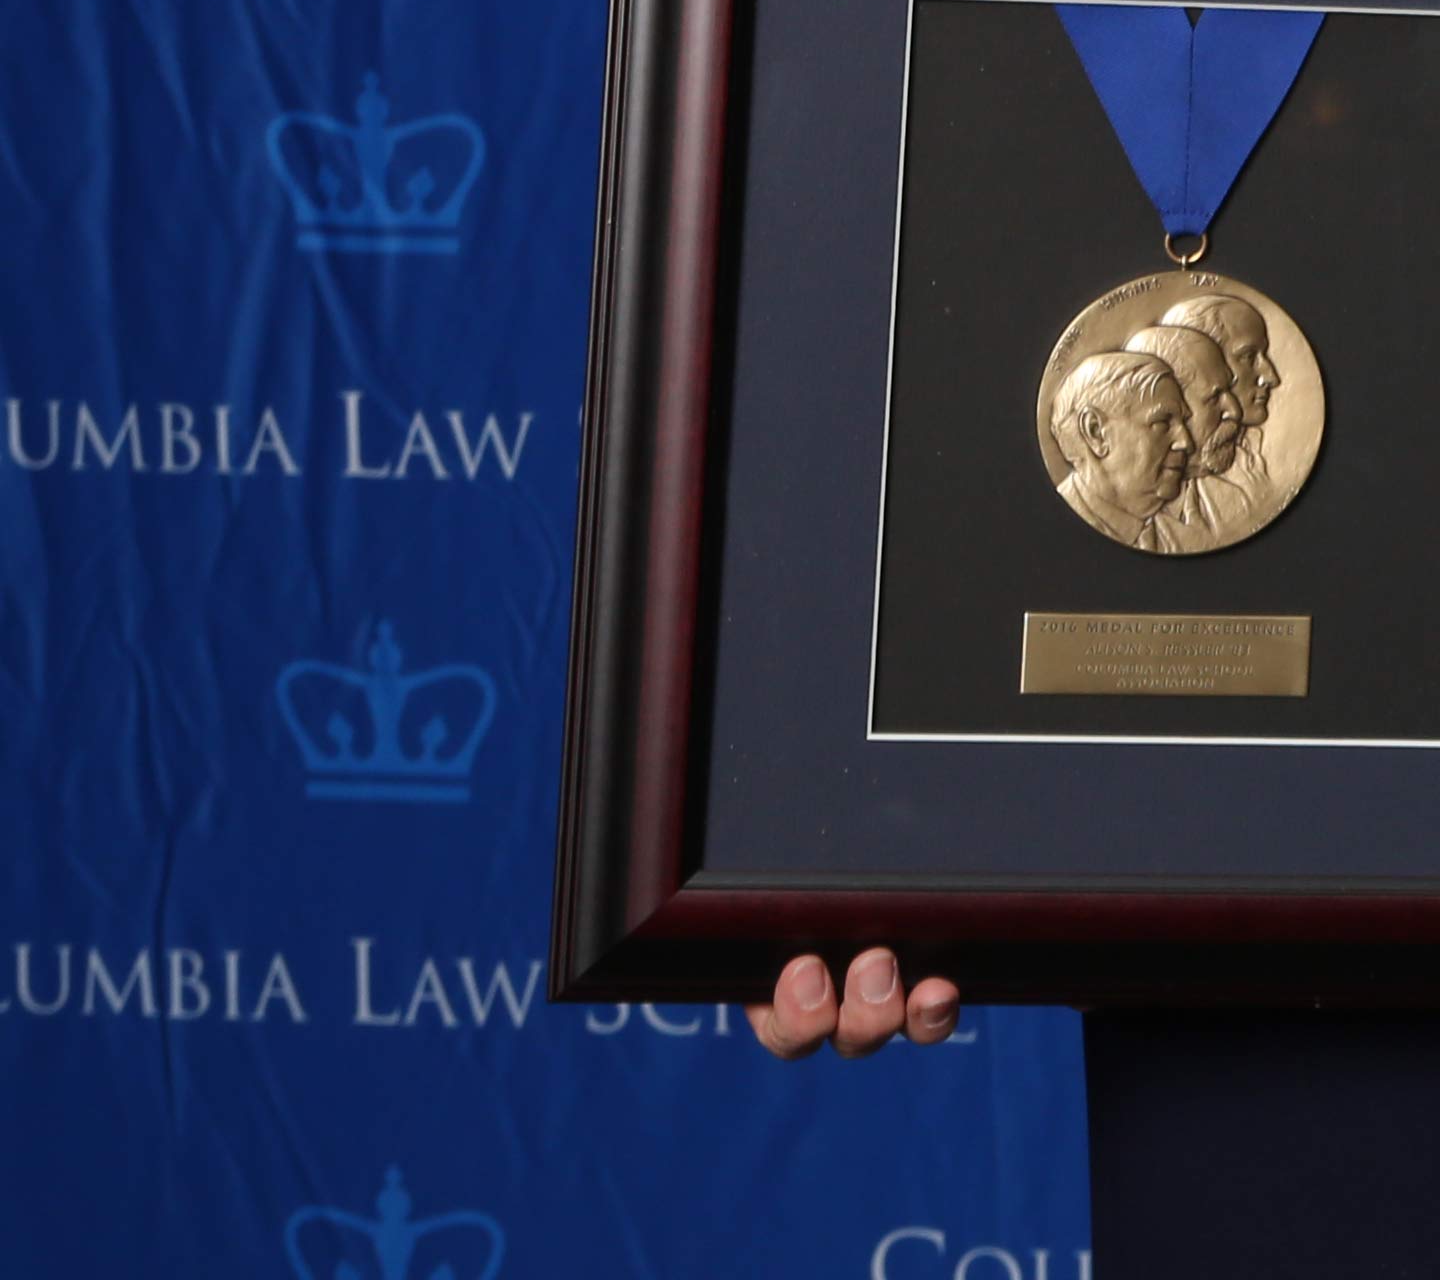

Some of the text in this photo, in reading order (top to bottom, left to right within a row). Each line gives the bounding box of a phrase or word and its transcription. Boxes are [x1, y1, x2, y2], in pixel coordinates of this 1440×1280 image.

[341, 388, 534, 481] LAW
[1086, 621, 1143, 634] MEDAL
[1151, 622, 1185, 635] FOR
[1191, 623, 1296, 637] EXCELLENCE
[0, 942, 307, 1023] UMBIA
[352, 936, 543, 1028] LAW
